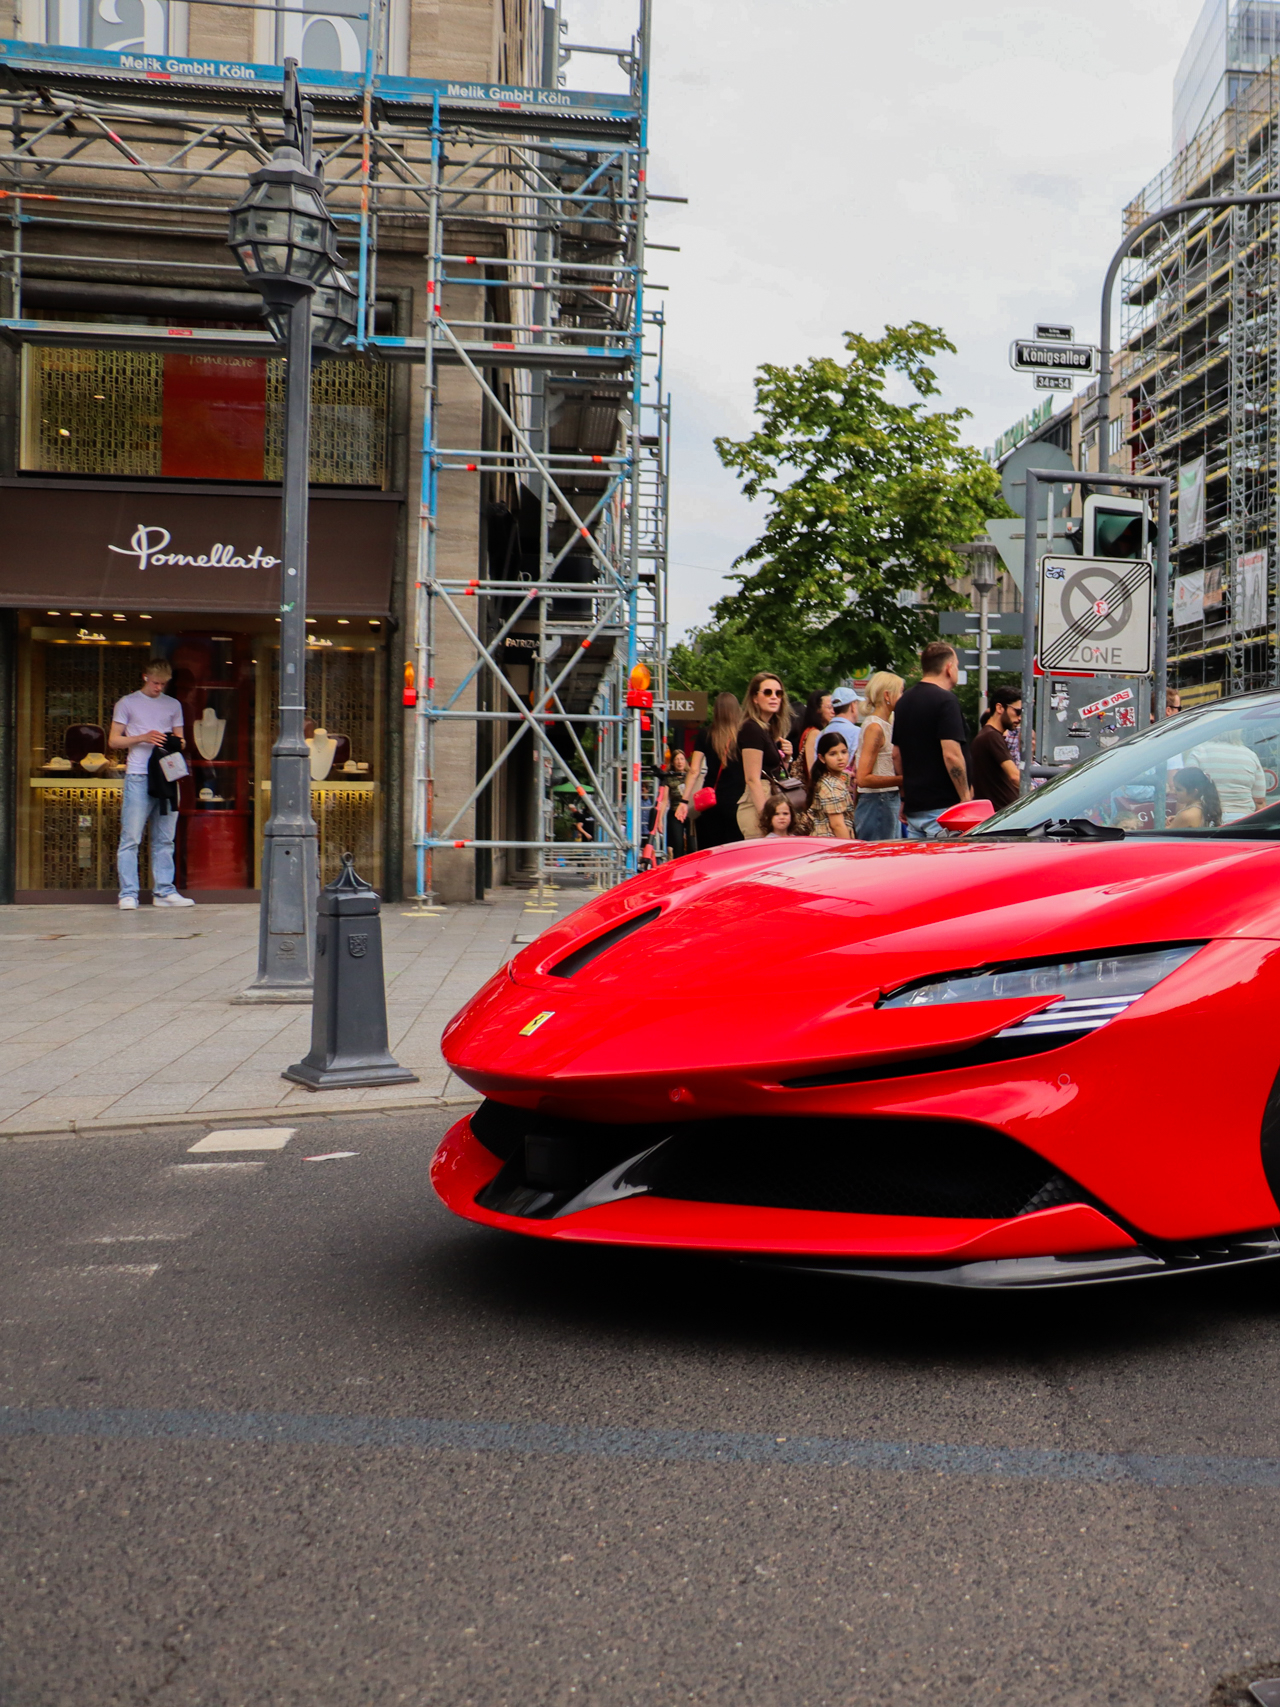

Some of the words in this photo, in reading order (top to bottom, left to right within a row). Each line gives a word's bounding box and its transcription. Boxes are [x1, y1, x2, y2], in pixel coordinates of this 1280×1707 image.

[120, 54, 162, 71] Melik
[166, 59, 215, 76] GmbH
[219, 63, 256, 79] Köln
[447, 83, 486, 99] Melik
[488, 87, 534, 103] GmbH
[537, 90, 571, 105] Köln
[1022, 346, 1087, 367] Königsallee
[1038, 377, 1070, 389] 34a-54
[107, 523, 282, 571] Pomellato
[1068, 645, 1123, 665] ZONE
